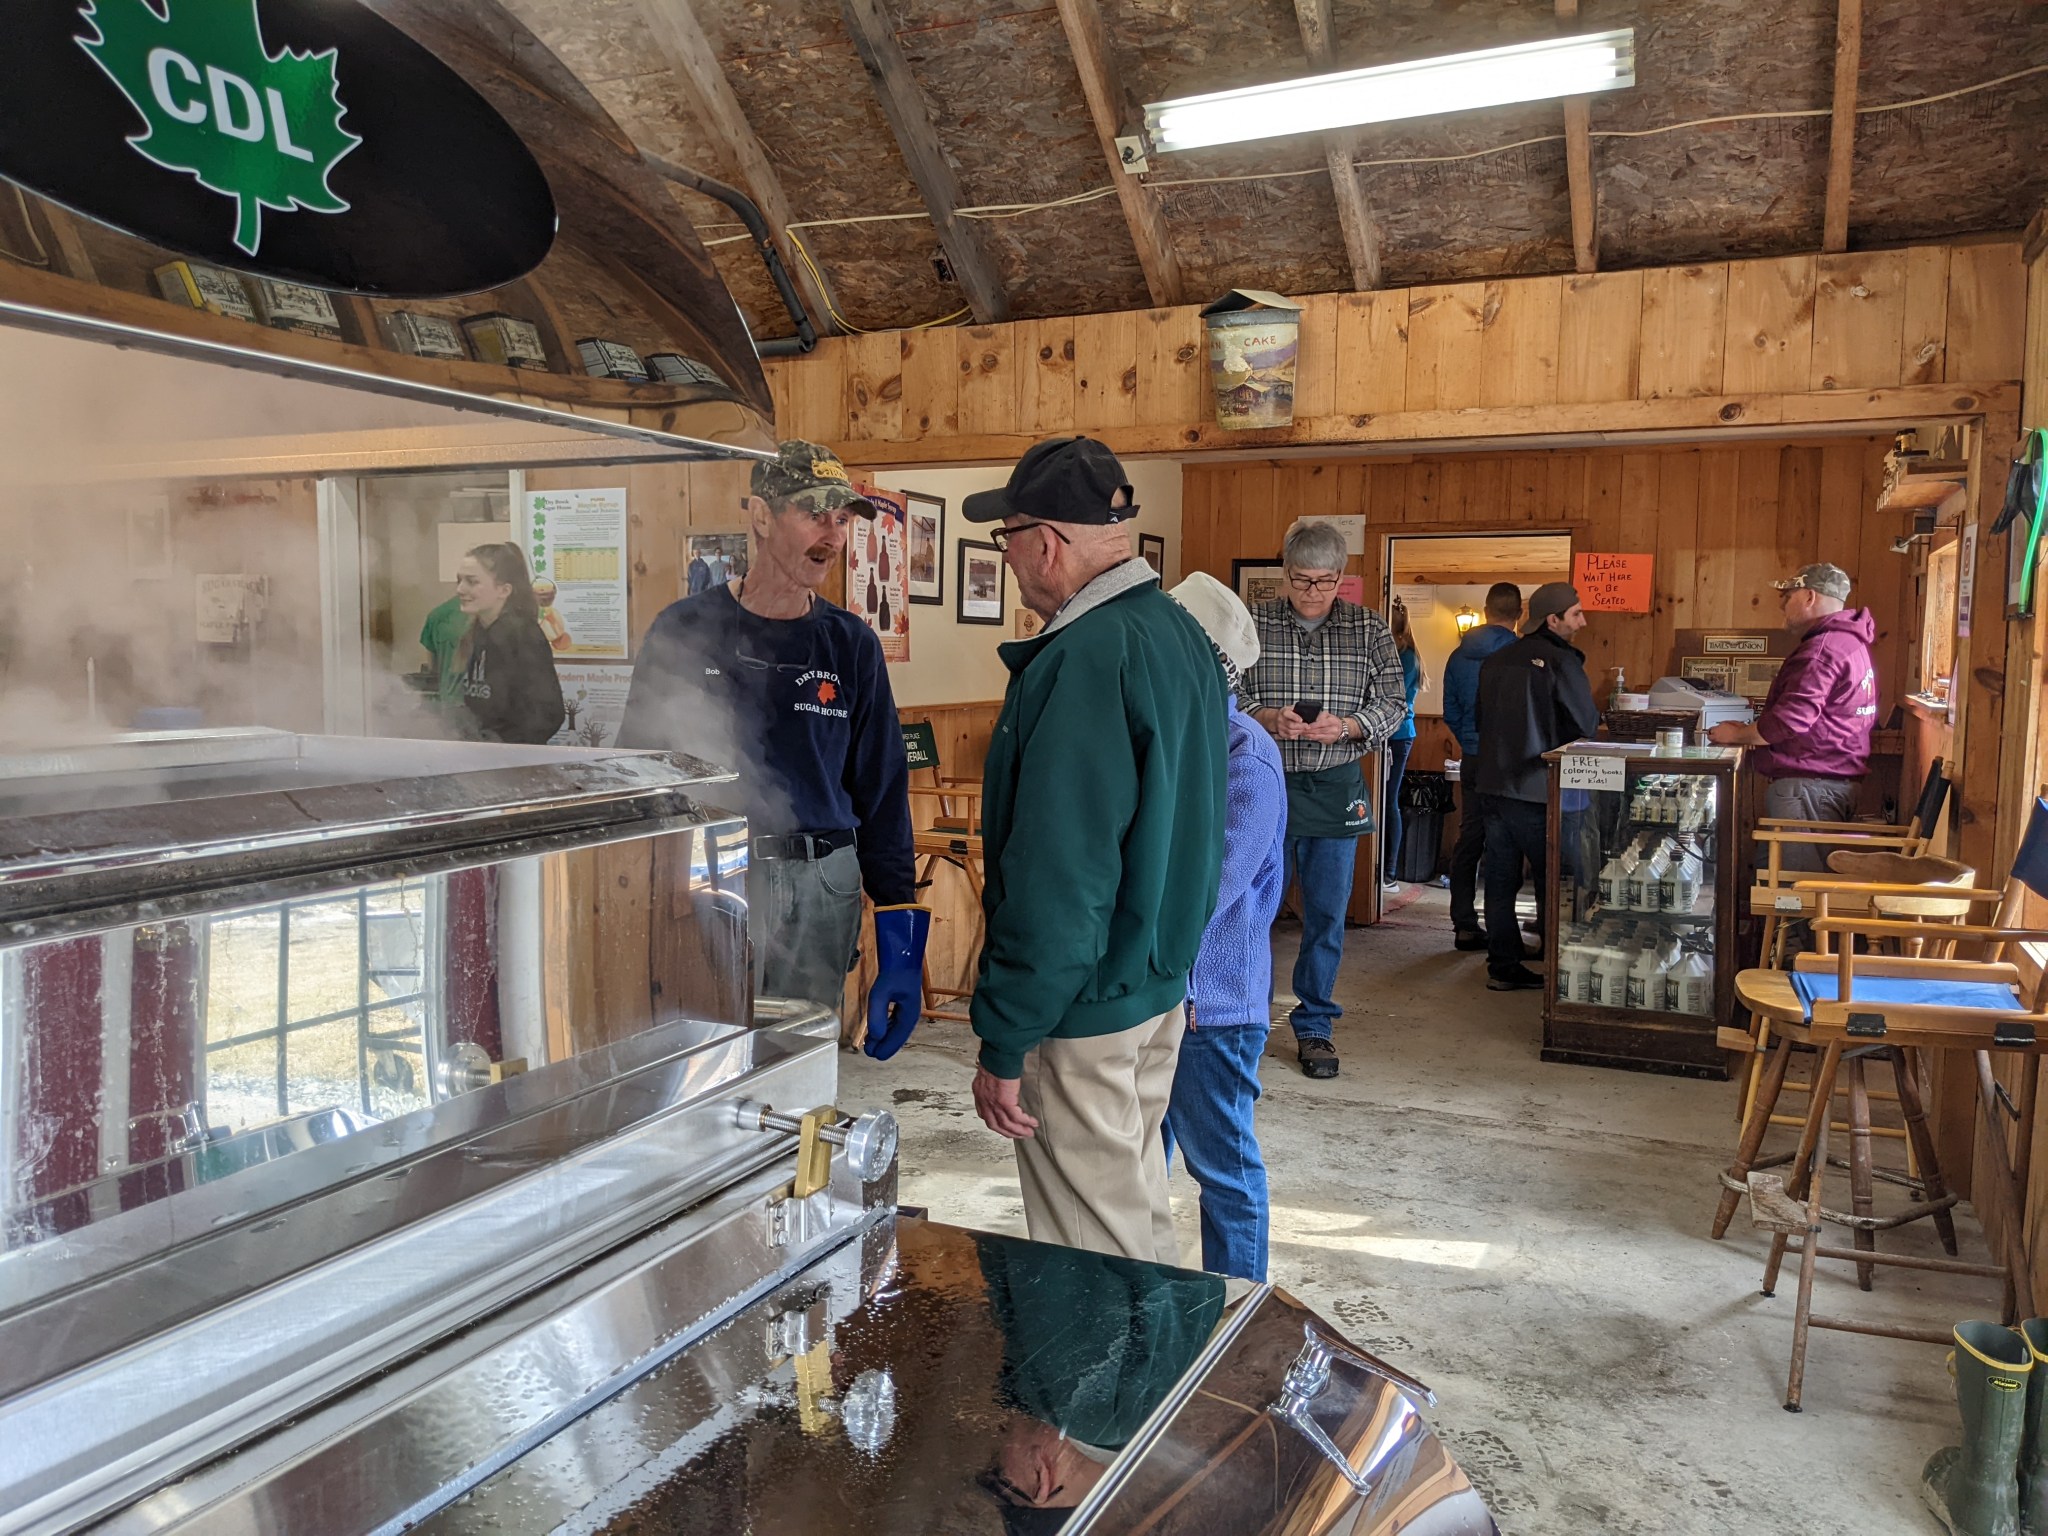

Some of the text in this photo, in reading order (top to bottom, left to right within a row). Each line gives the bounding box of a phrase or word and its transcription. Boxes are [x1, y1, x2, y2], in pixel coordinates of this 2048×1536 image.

[147, 47, 314, 163] CDL
[1243, 335, 1277, 348] CAKE
[1587, 554, 1627, 571] PLEASE
[1583, 572, 1632, 582] WAIT HERE
[1587, 584, 1619, 593] TO BE
[1592, 593, 1626, 606] SEATED
[1709, 641, 1763, 650] TIMES UNION
[705, 667, 721, 675] Bob
[795, 670, 816, 687] DRY
[794, 703, 848, 719] SUGAR HOUSE
[906, 741, 918, 750] MEN
[1572, 757, 1601, 768] FREE
[1562, 768, 1623, 779] coloring books
[1588, 777, 1608, 785] kids!
